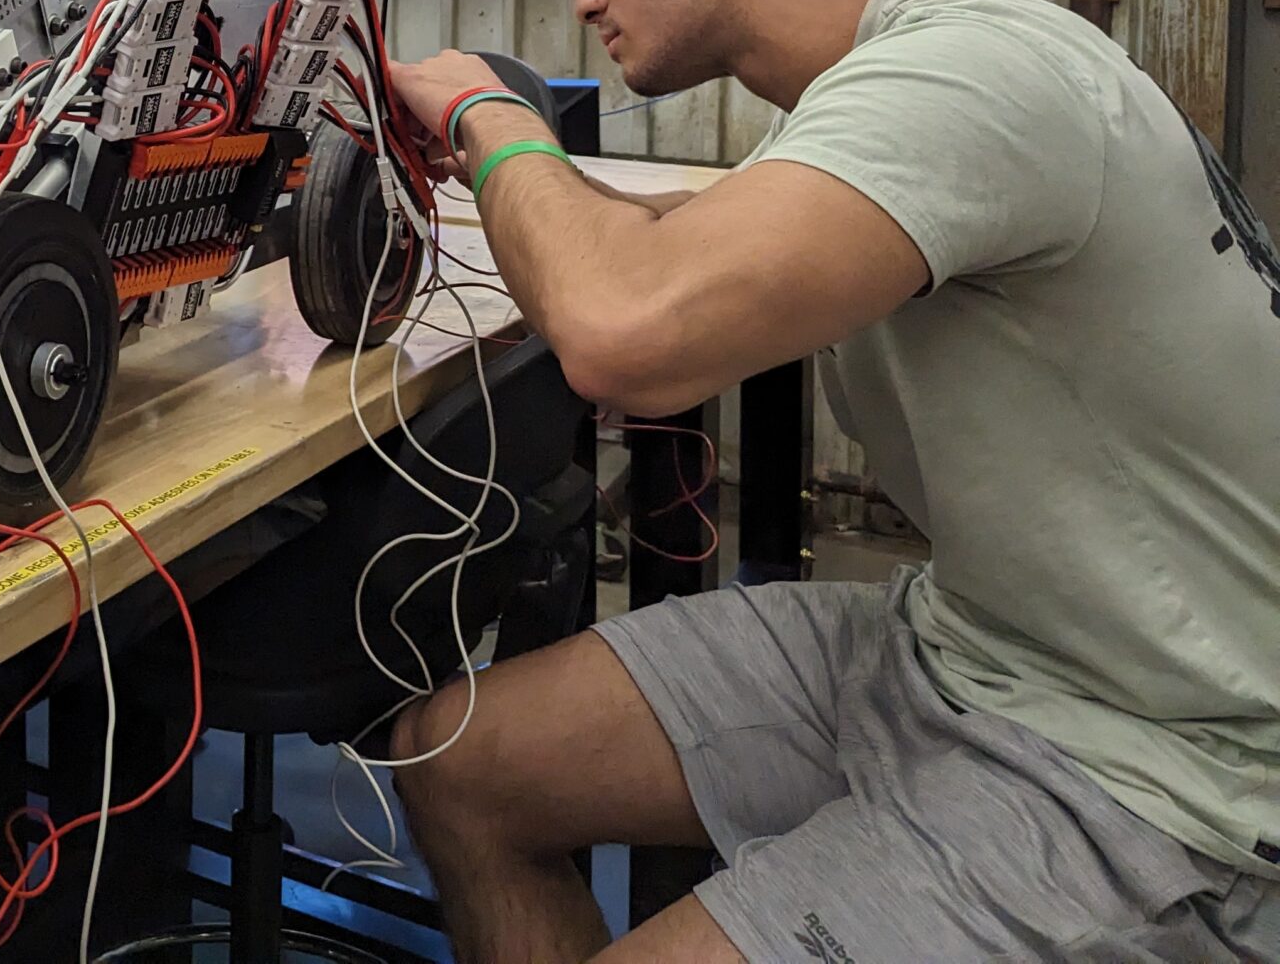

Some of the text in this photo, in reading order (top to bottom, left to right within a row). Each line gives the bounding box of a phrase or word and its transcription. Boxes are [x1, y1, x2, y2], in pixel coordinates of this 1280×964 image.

[151, 50, 168, 85] SPARK
[140, 97, 154, 132] SPARK
[802, 912, 857, 964] Reeb
